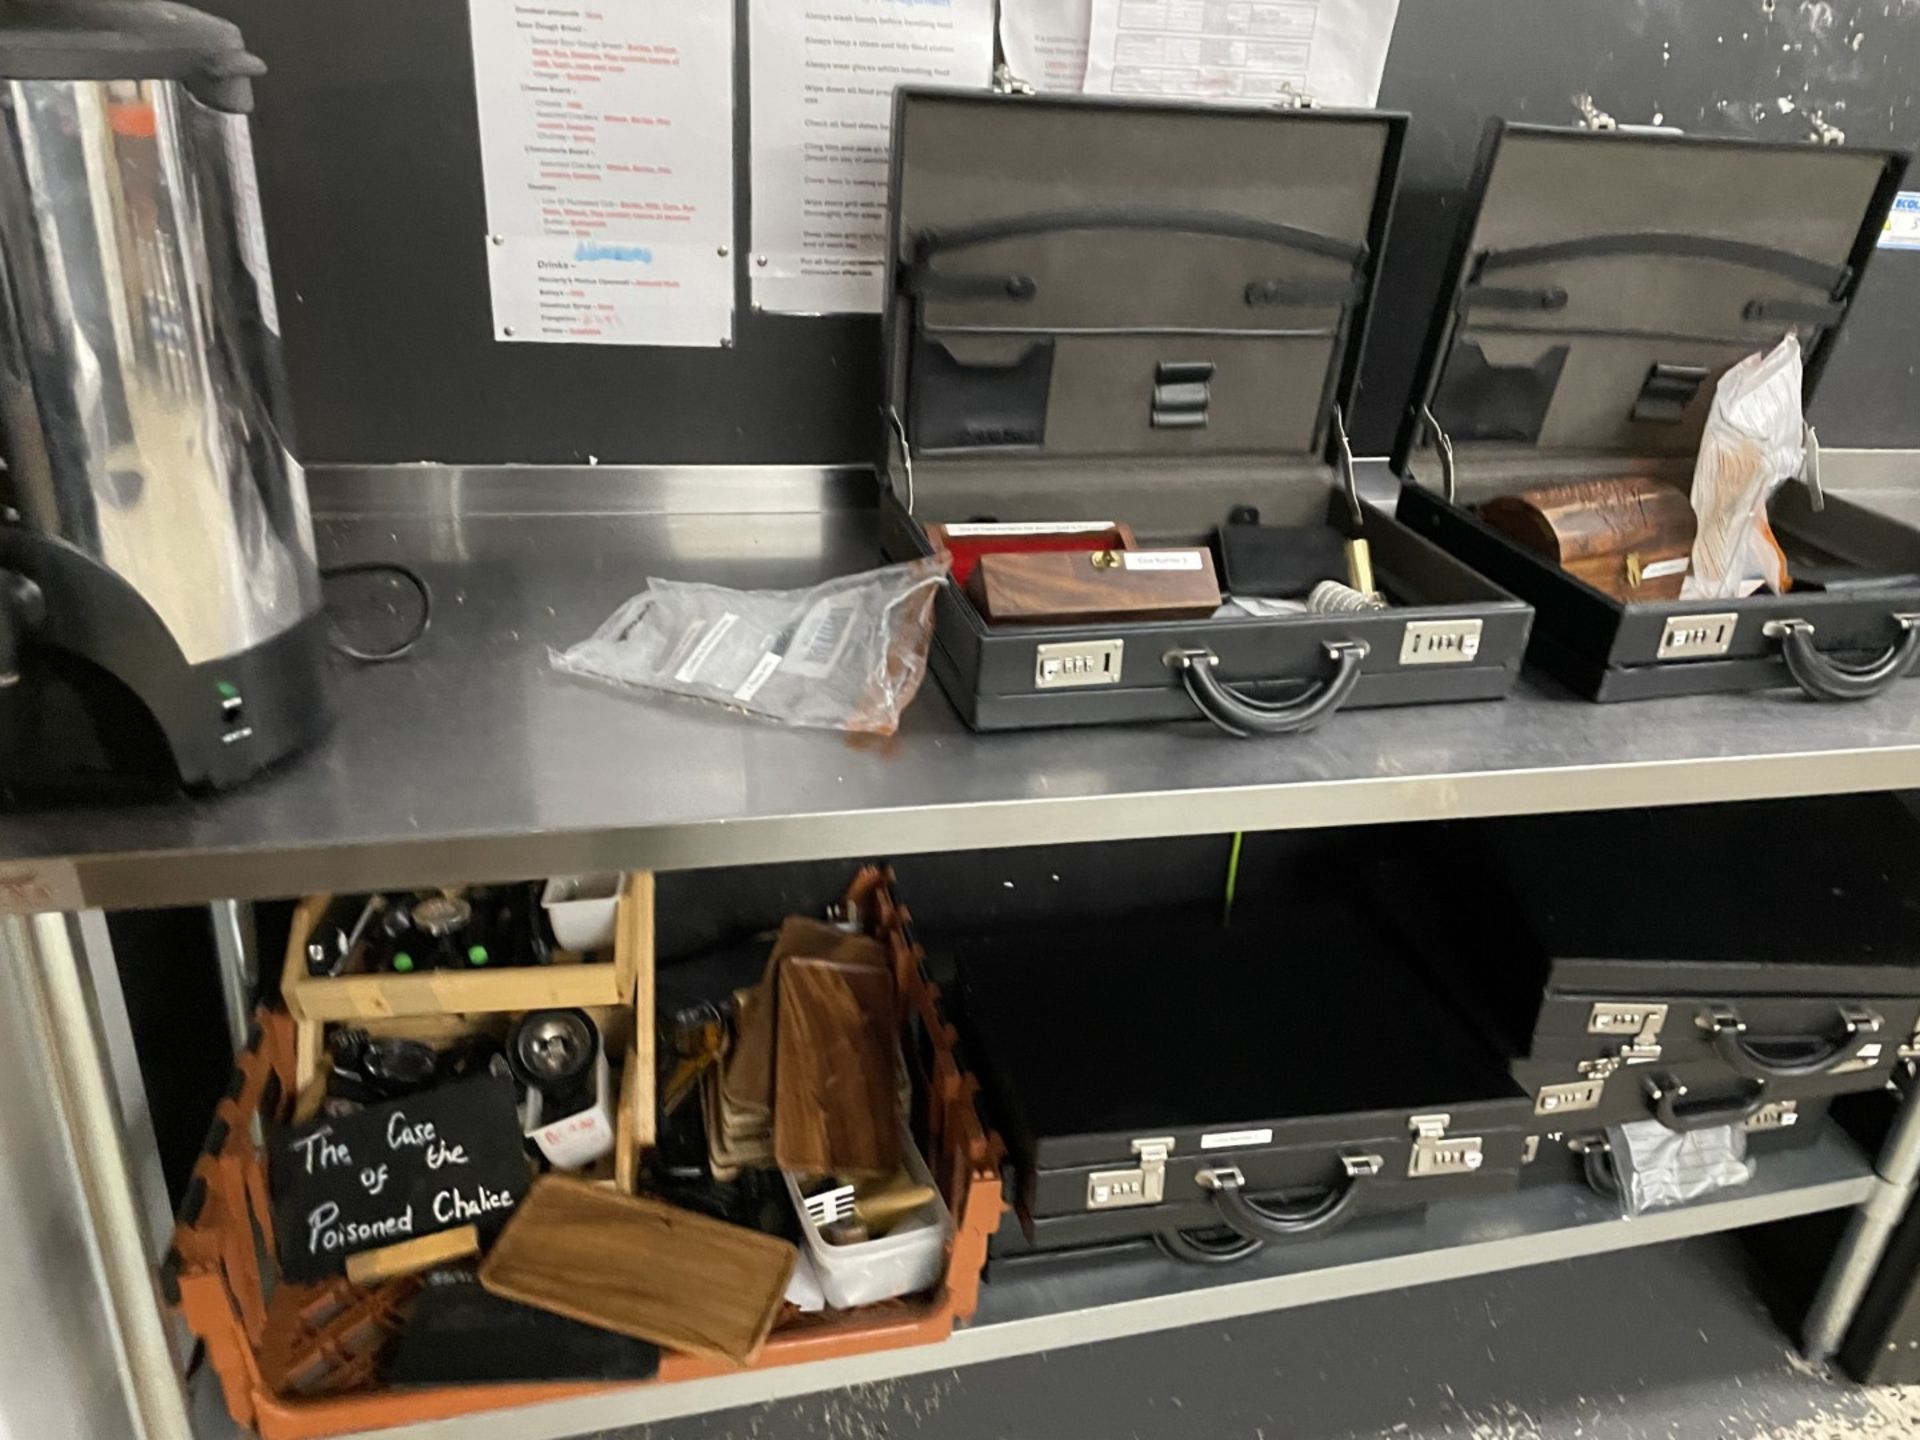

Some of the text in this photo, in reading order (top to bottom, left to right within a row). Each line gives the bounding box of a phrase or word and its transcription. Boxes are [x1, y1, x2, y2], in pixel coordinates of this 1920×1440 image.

[805, 11, 831, 21] Always
[904, 19, 935, 29] handling
[805, 37, 831, 45] Always
[805, 60, 831, 69] Always
[805, 84, 823, 93] Wipe
[537, 260, 568, 269] Drinks
[290, 1111, 437, 1174] The Case
[360, 1140, 469, 1195] of the
[307, 1187, 515, 1254] Poisoned Chalice
